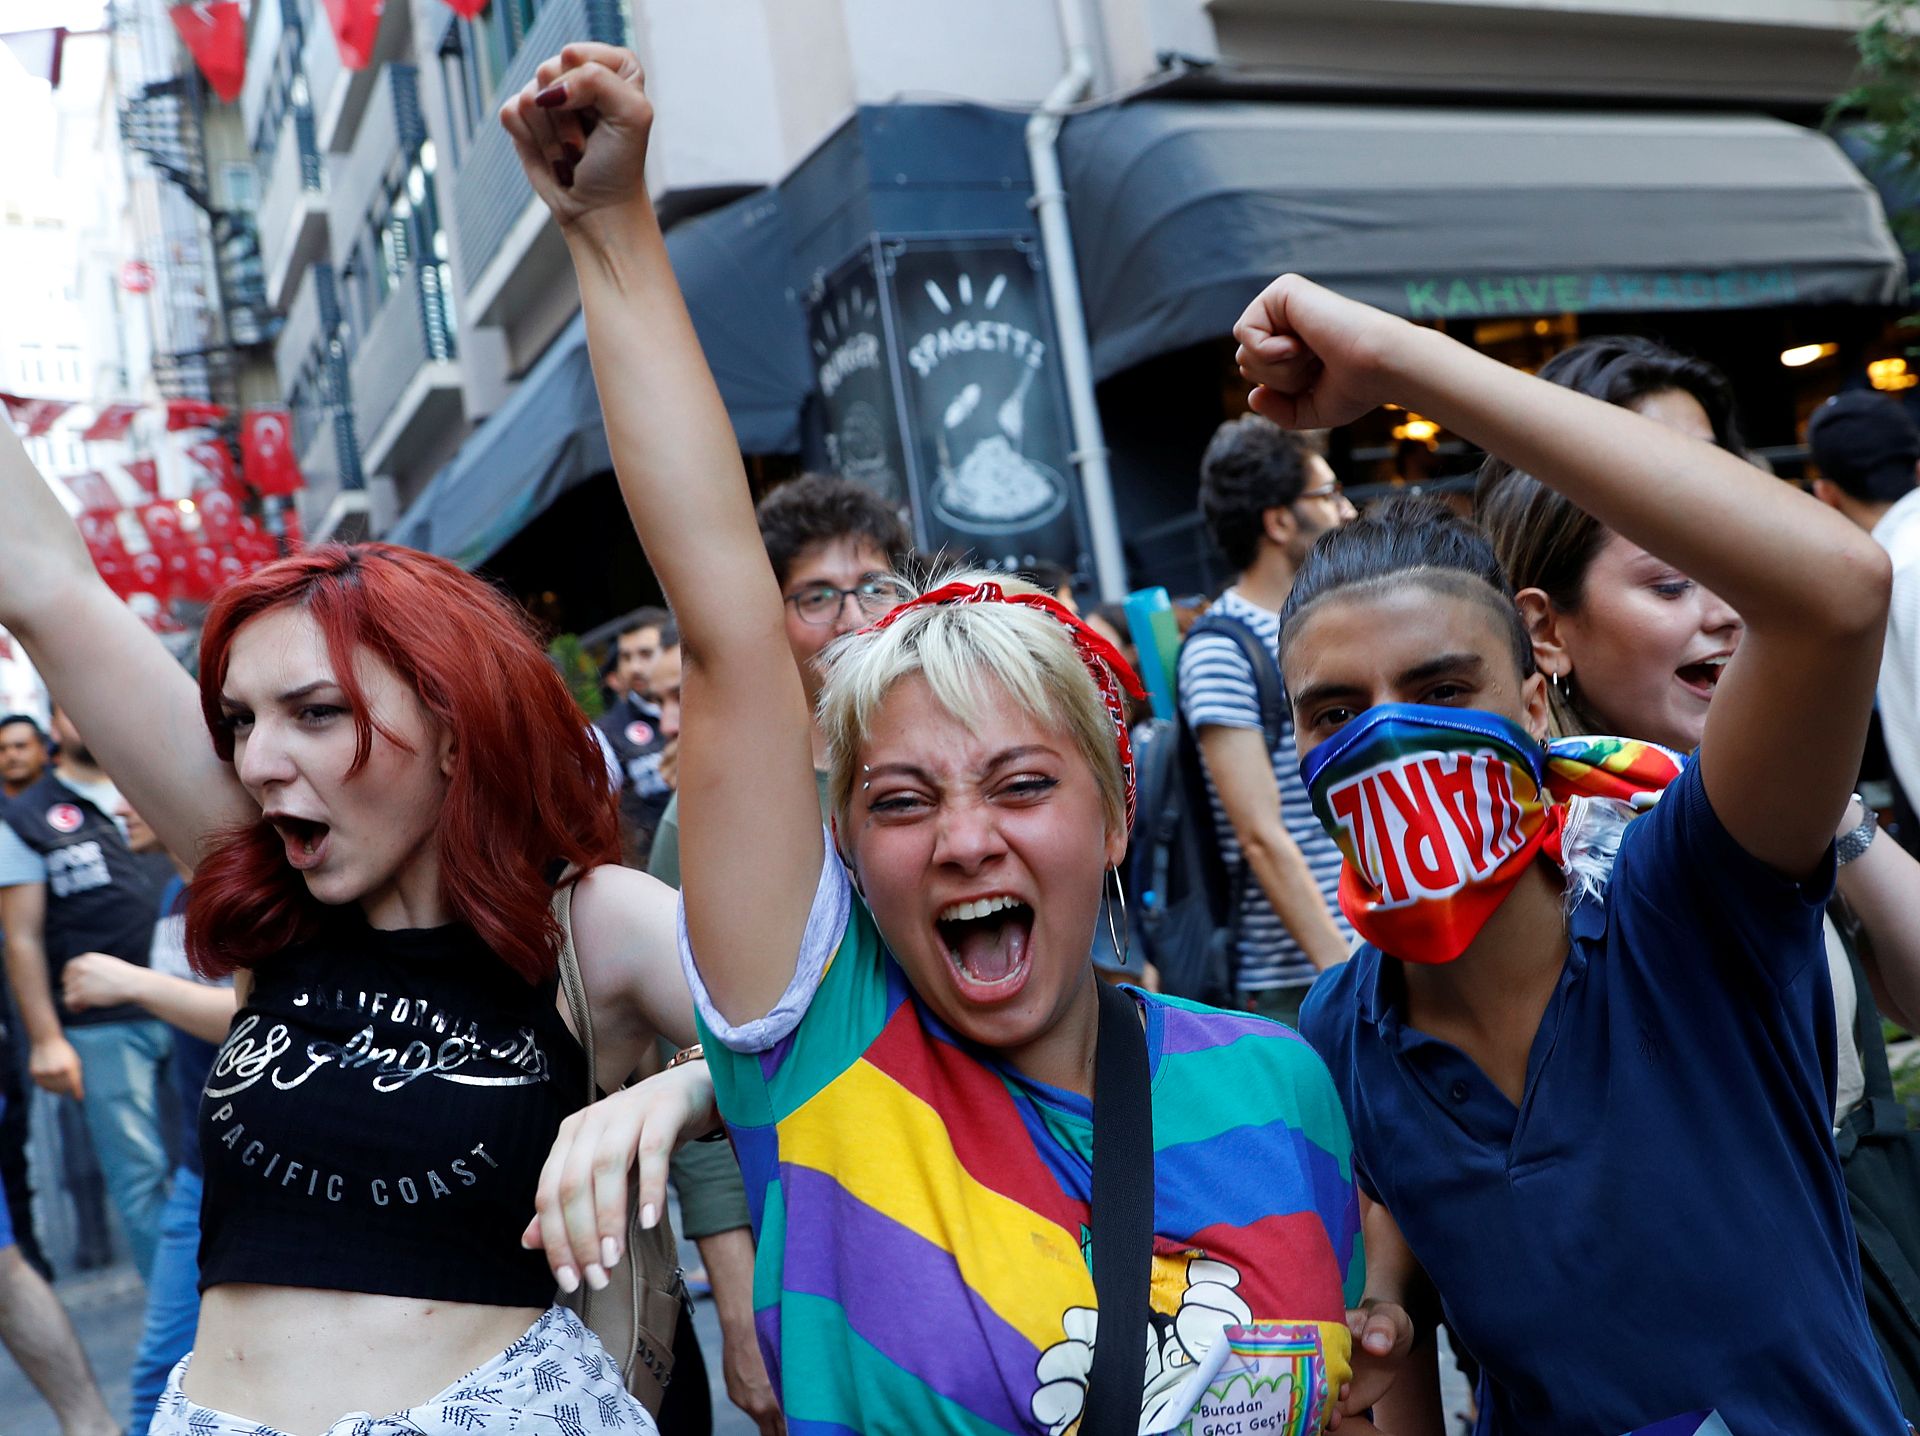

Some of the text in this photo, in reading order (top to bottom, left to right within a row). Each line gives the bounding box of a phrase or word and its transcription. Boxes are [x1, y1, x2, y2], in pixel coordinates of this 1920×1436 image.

[211, 1101, 499, 1206] PACIFIC COAST
[1201, 1400, 1263, 1418] Buradan
[1203, 1409, 1286, 1436] GACI Geçti
